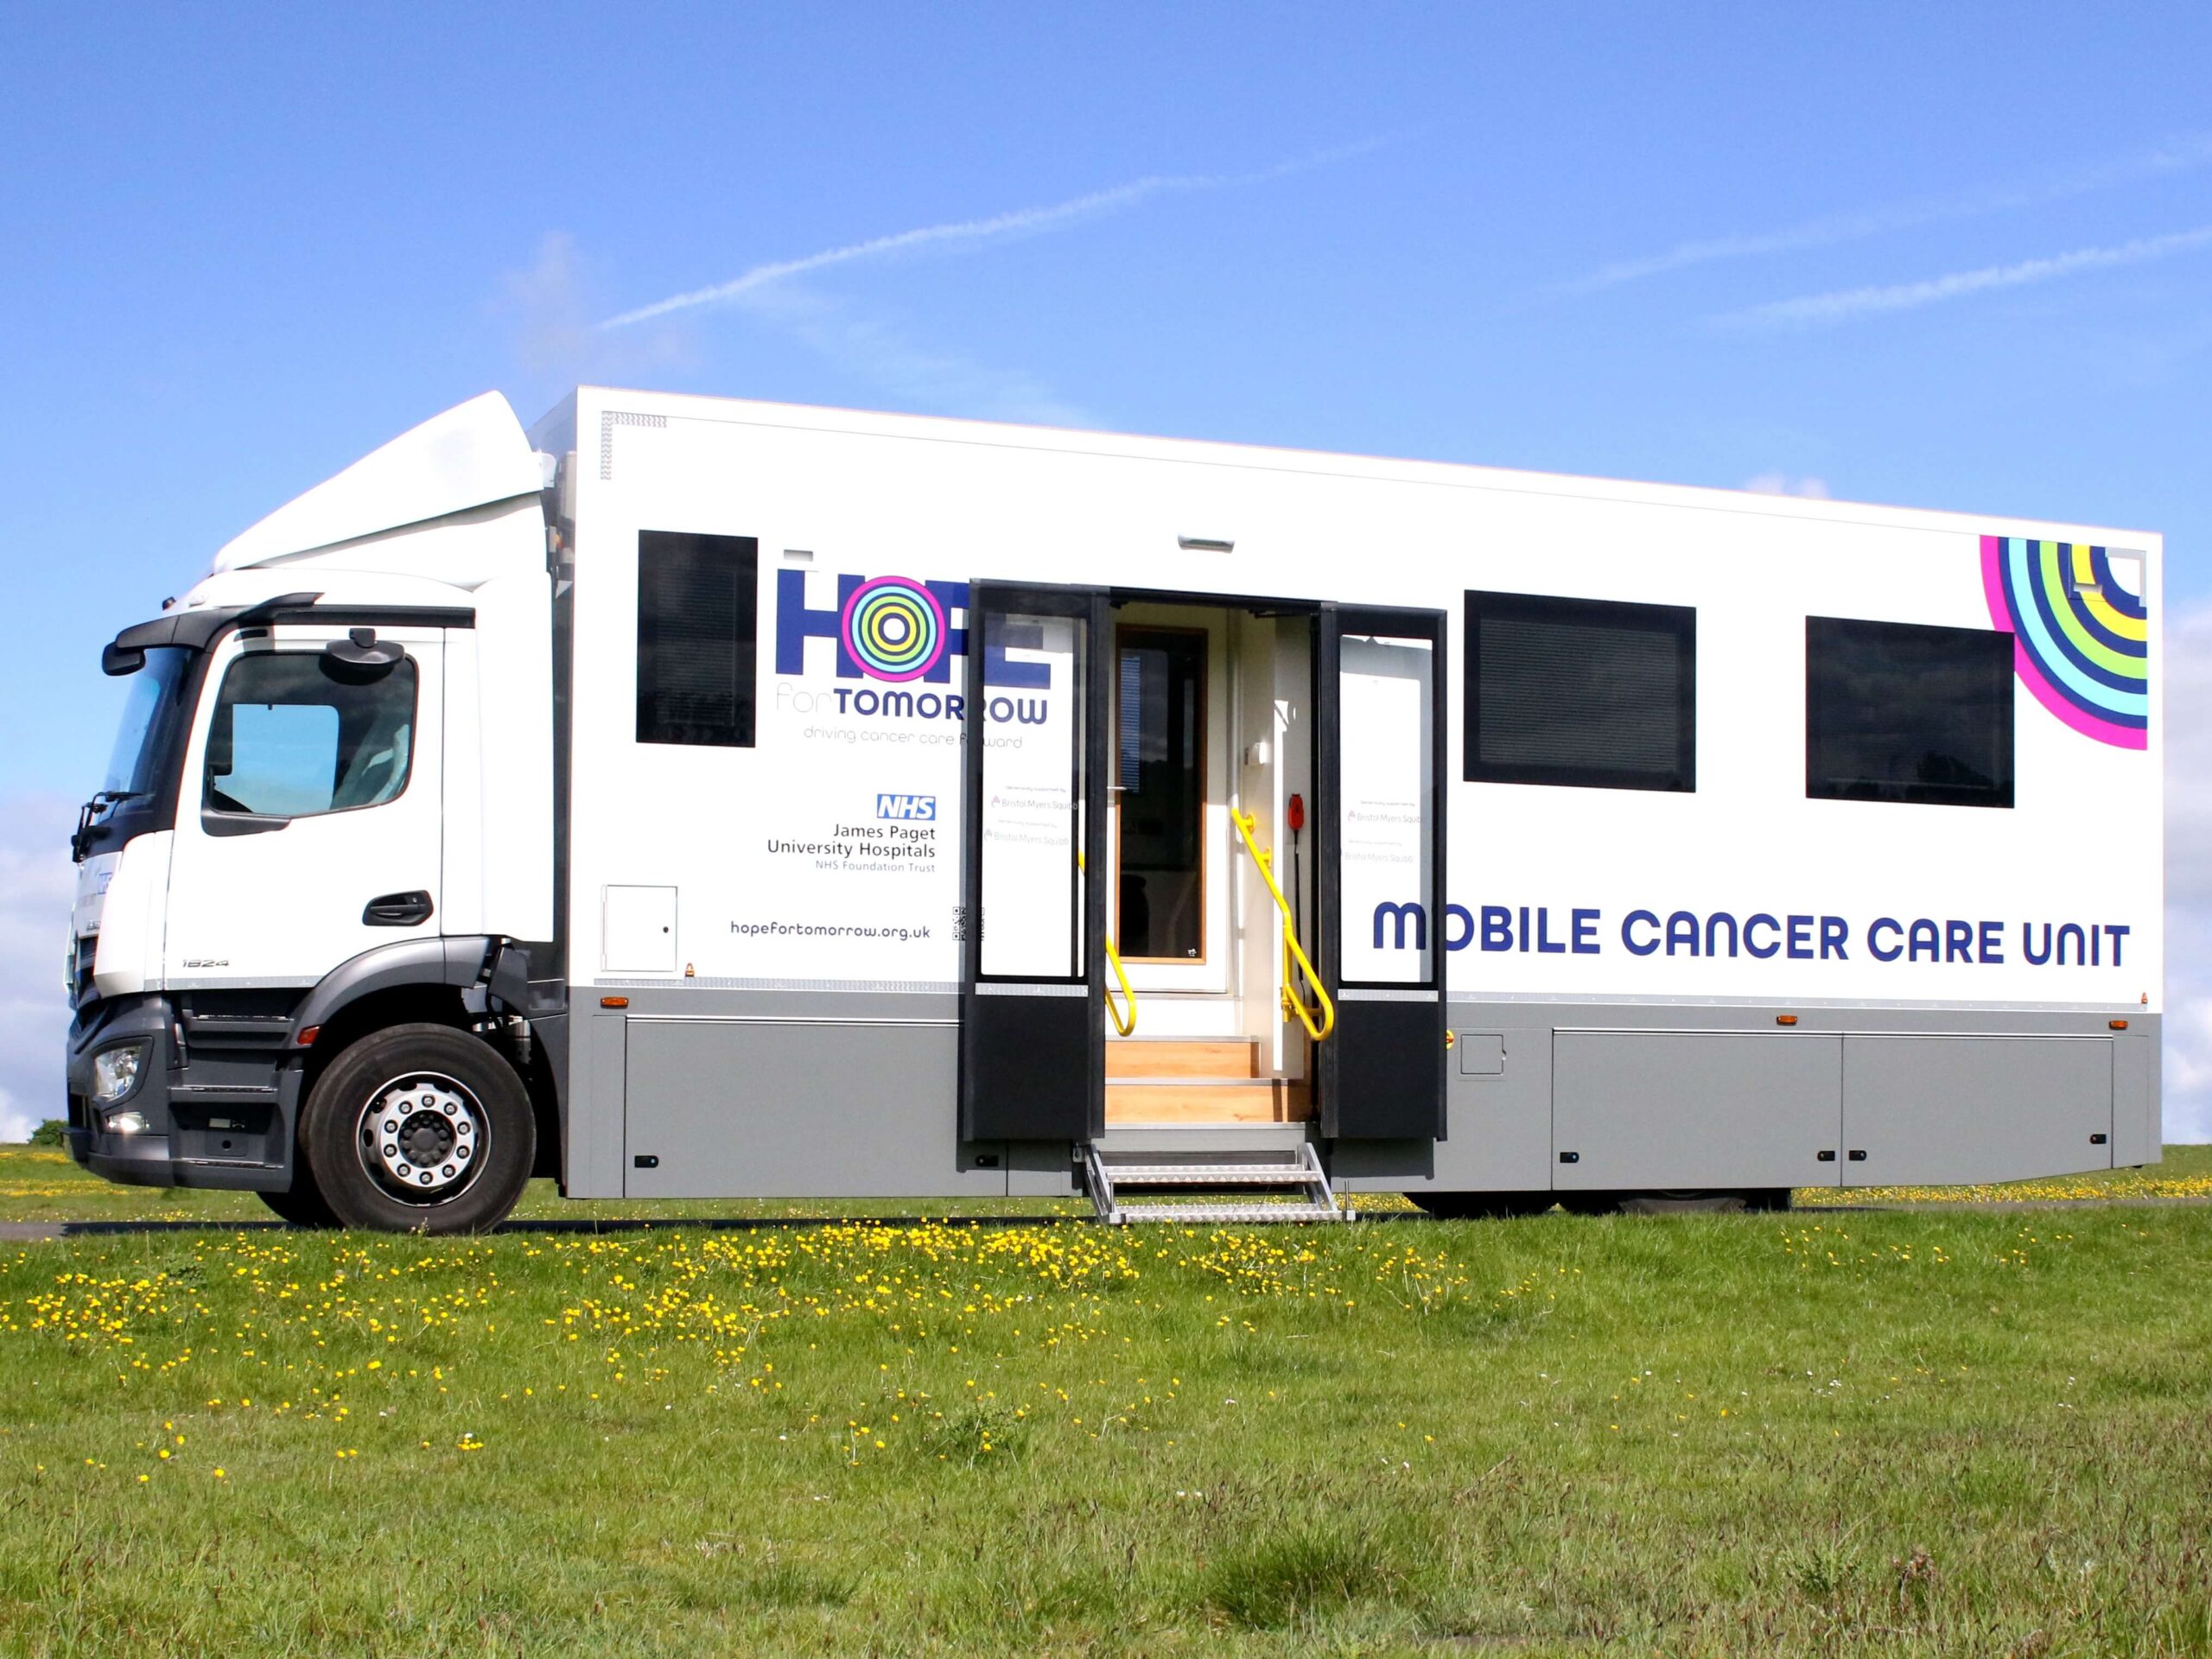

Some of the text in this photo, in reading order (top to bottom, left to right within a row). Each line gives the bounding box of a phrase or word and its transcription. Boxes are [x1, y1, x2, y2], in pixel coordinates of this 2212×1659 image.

[833, 688, 1048, 725] TOMOROW
[804, 726, 1023, 749] driving cancer care fward
[877, 795, 935, 819] NHS
[1001, 798, 1027, 808] Bristol
[1027, 799, 1052, 810] Myers
[1357, 812, 1380, 823] Bristol
[1380, 813, 1402, 823] Myers
[833, 823, 936, 843] James Paget
[767, 839, 936, 860] University Hospitals
[816, 860, 935, 873] NHS Foundation Trust
[730, 920, 931, 941] hopefortomorrow.org.uk
[1373, 901, 2131, 968] MOBILE CANCER CARE UNIT
[182, 959, 230, 968] 1824
